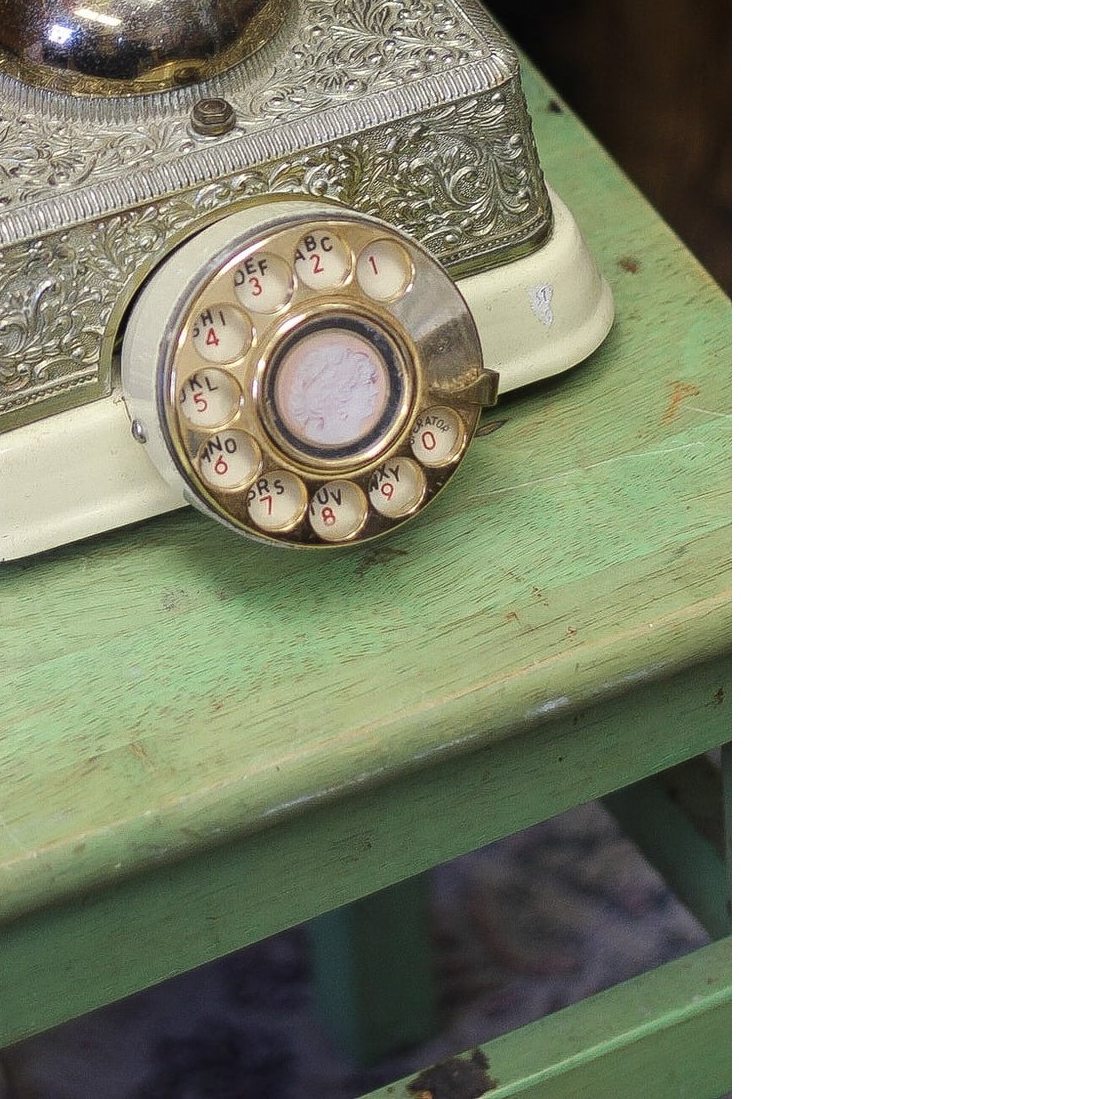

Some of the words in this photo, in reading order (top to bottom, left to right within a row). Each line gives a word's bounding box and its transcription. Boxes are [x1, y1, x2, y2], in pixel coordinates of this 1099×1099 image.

[294, 236, 333, 263] ABC
[310, 254, 324, 274] 2
[368, 256, 378, 275] 1
[249, 276, 263, 296] 3
[206, 328, 219, 346] 4
[193, 392, 208, 412] 5
[421, 431, 437, 451] 0
[214, 455, 228, 475] 6
[381, 483, 394, 501] 9
[259, 495, 273, 515] 7
[321, 507, 336, 526] 8
